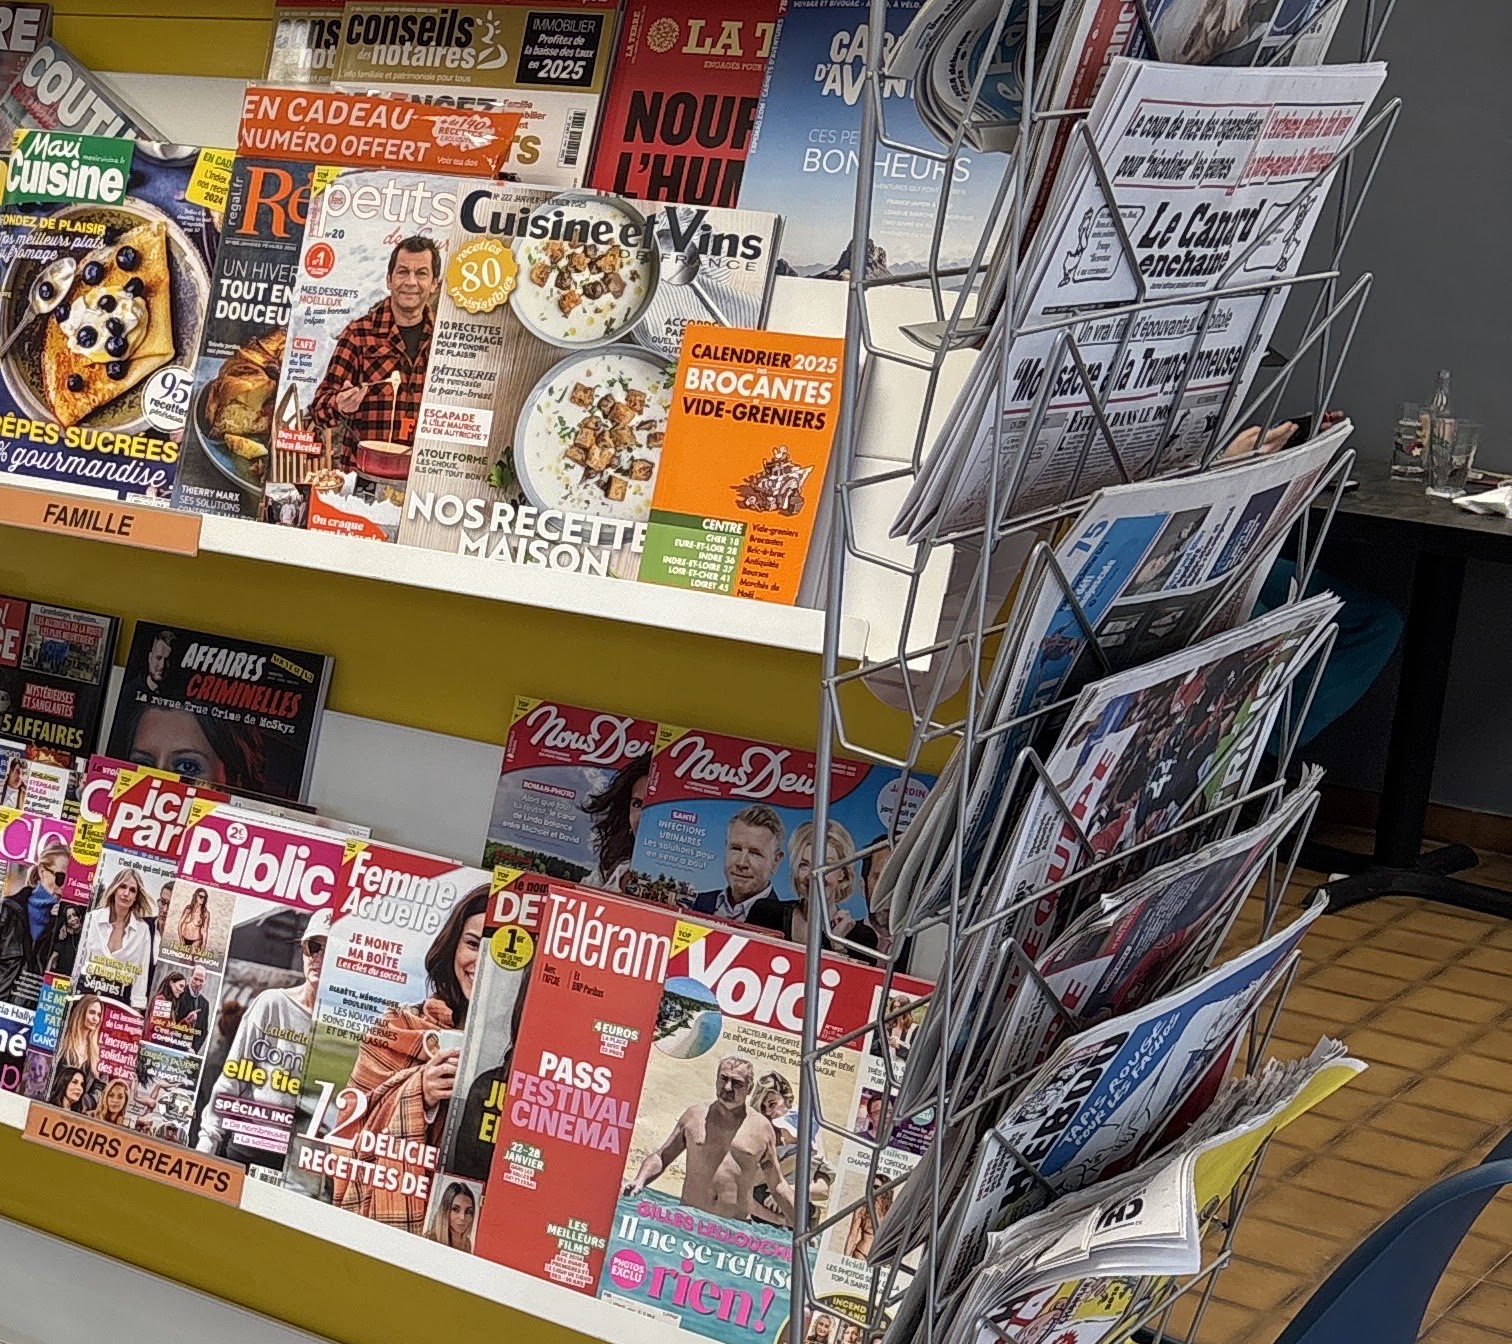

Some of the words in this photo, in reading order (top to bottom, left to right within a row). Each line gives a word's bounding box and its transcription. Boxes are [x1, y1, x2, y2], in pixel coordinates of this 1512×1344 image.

[346, 9, 475, 51] conseils
[531, 17, 597, 35] IMMOBILIER
[371, 42, 477, 70] notaires
[538, 58, 587, 80] 2025
[241, 94, 276, 122] EN
[284, 97, 415, 133] CADEAU
[25, 136, 82, 161] Maxi
[239, 126, 336, 156] NUMÉRO
[341, 134, 431, 164] OFFERT
[8, 150, 125, 201] Cuisine
[460, 190, 612, 246] Cuisine
[661, 206, 763, 261] Vins
[1136, 200, 1179, 249] Le
[1178, 197, 1267, 249] Canard
[690, 344, 791, 368] CALENDRIER
[792, 352, 839, 374] 2025
[683, 367, 832, 405] BROCANTES
[682, 396, 827, 431] VIDE-GRENIERS
[64, 426, 178, 463] SUCRÉES
[43, 503, 134, 536] FAMILLE
[407, 490, 485, 530] NOS
[701, 518, 743, 535] CENTRE
[706, 534, 727, 545] CHER
[728, 536, 740, 546] 18
[690, 578, 715, 591] LOIRET
[717, 583, 730, 593] 45
[180, 642, 268, 682] AFFAIRES
[136, 690, 148, 702] La
[151, 697, 181, 709] revue
[185, 702, 208, 715] True
[212, 707, 241, 721] Crime
[244, 714, 256, 724] de
[259, 718, 295, 734] McSkyz
[186, 675, 304, 718] CRIMINELLES
[181, 828, 336, 905] Public
[348, 851, 457, 909] Femme
[340, 884, 442, 936] Actuelle
[1131, 1011, 1181, 1079] FACHOS
[539, 1053, 614, 1094] PASS
[1058, 1094, 1108, 1148] TAPIS
[1108, 1020, 1167, 1095] ROUGE
[510, 1070, 634, 1130] FESTIVAL
[509, 1101, 621, 1154] CINEMA
[38, 1116, 123, 1161] LOISIRS
[124, 1139, 231, 1194] CREATIFS
